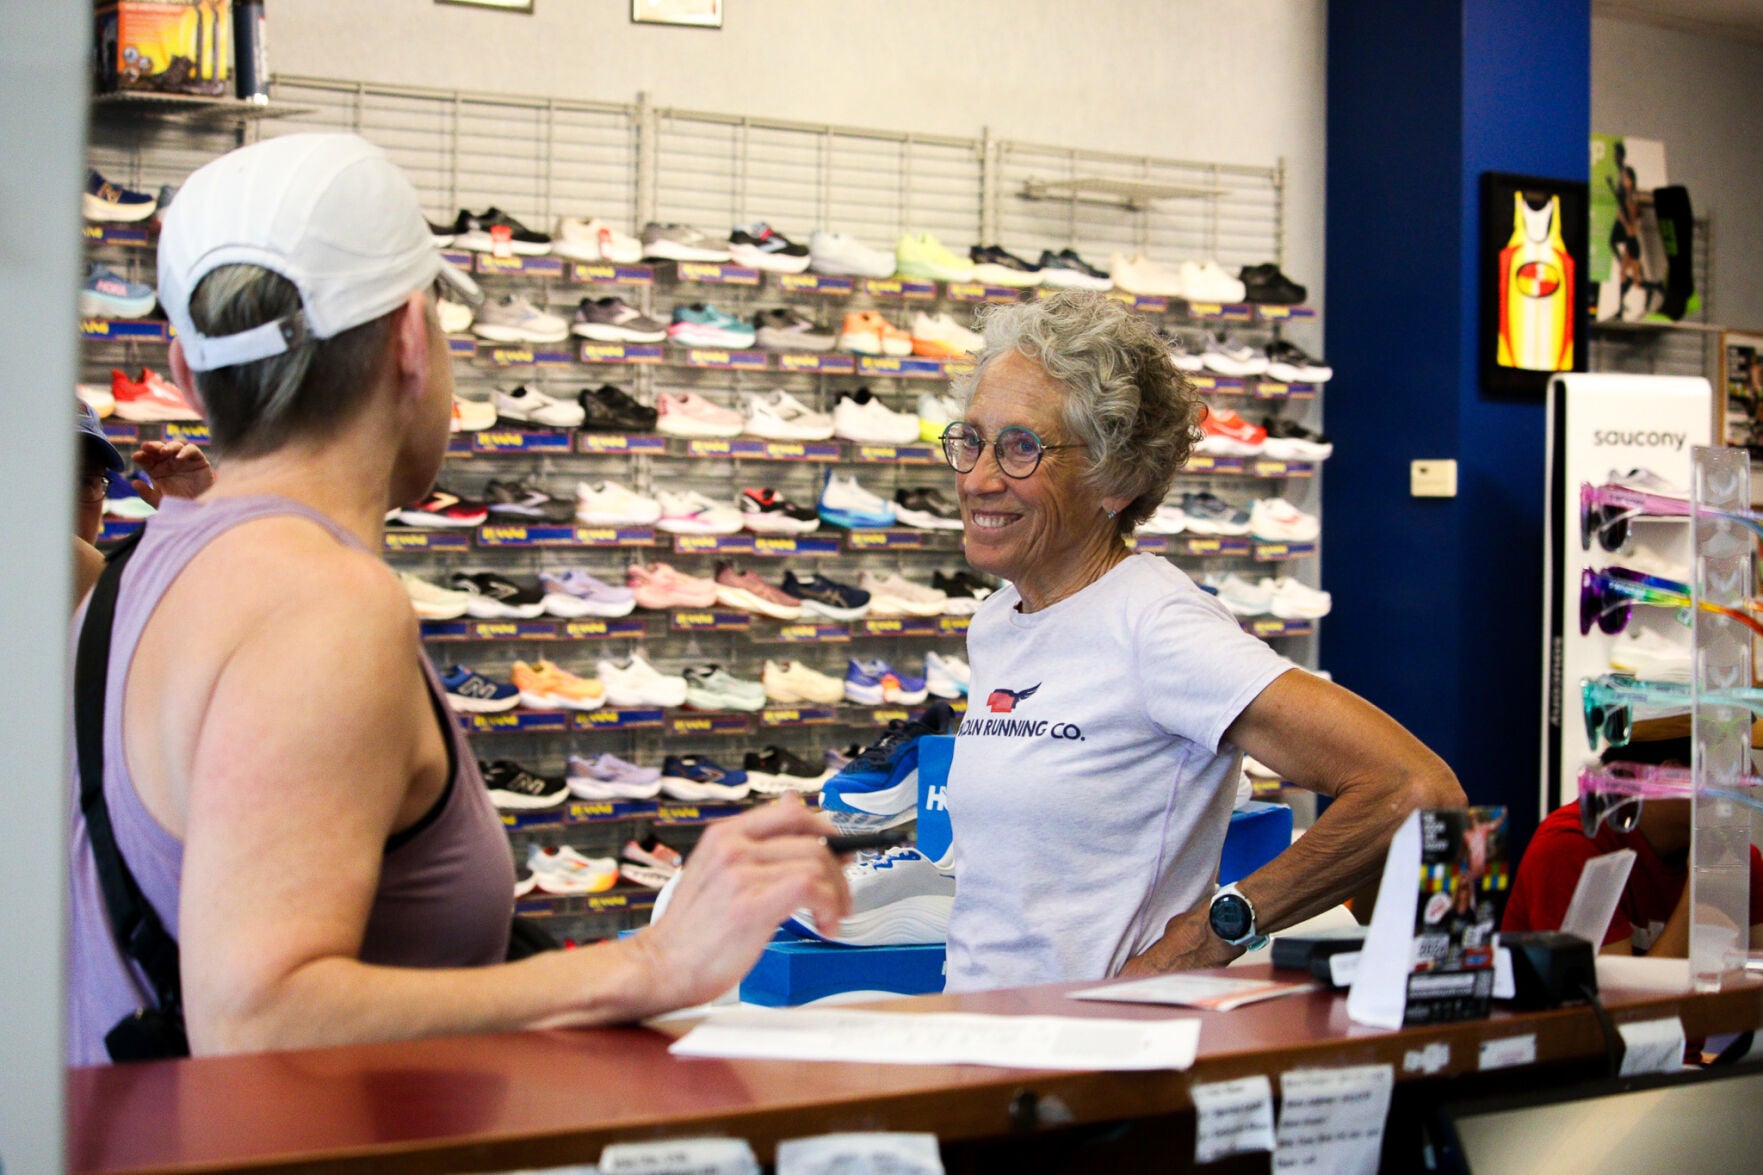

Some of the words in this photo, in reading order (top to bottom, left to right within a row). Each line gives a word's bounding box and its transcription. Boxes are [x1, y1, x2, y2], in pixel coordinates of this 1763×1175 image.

[1593, 429, 1687, 452] saucony
[983, 718, 1048, 738] RUNNING
[1050, 721, 1086, 742] CO.
